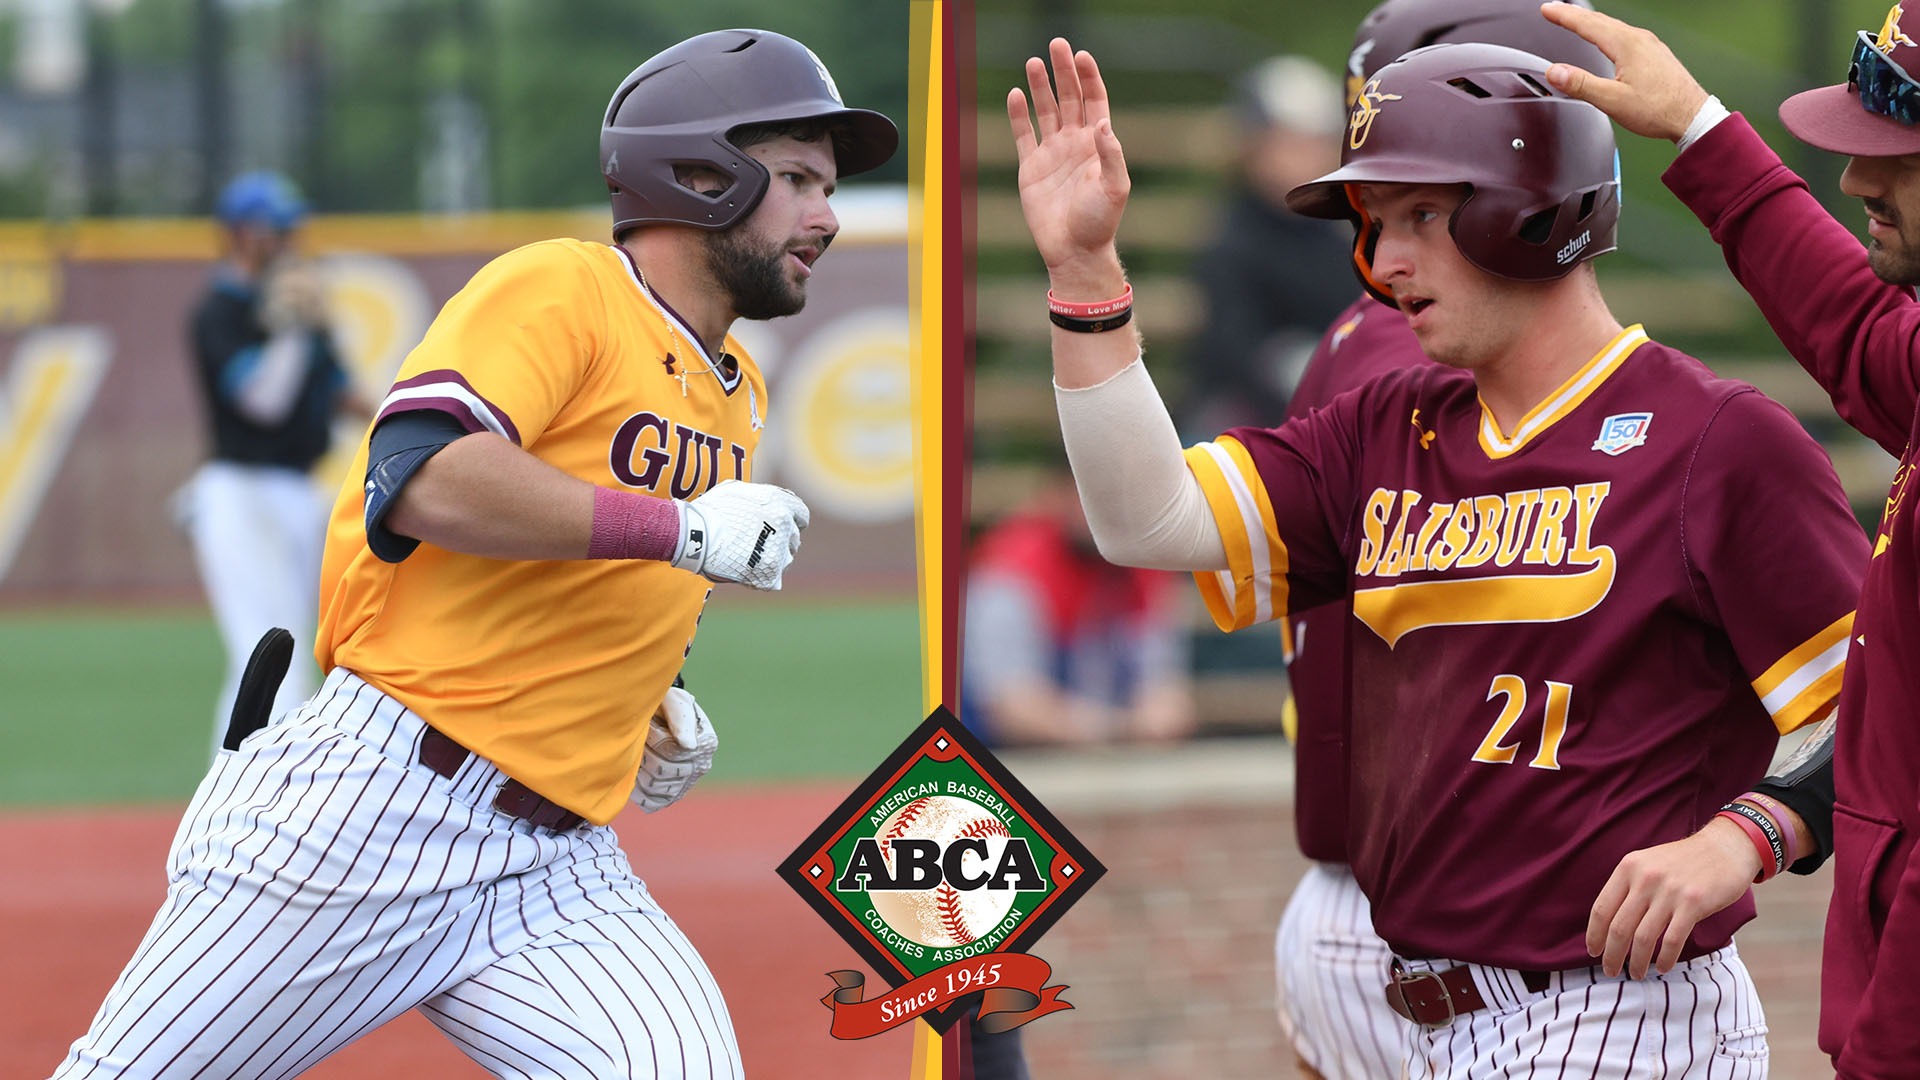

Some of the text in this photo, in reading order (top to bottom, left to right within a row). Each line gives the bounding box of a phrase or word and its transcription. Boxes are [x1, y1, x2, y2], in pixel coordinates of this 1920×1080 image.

[1087, 303, 1110, 315] Love
[1609, 423, 1638, 439] 50
[1355, 481, 1612, 577] SALISBURY
[1471, 673, 1573, 771] 21
[1737, 805, 1757, 817] DAY
[1754, 814, 1778, 841] EVERY
